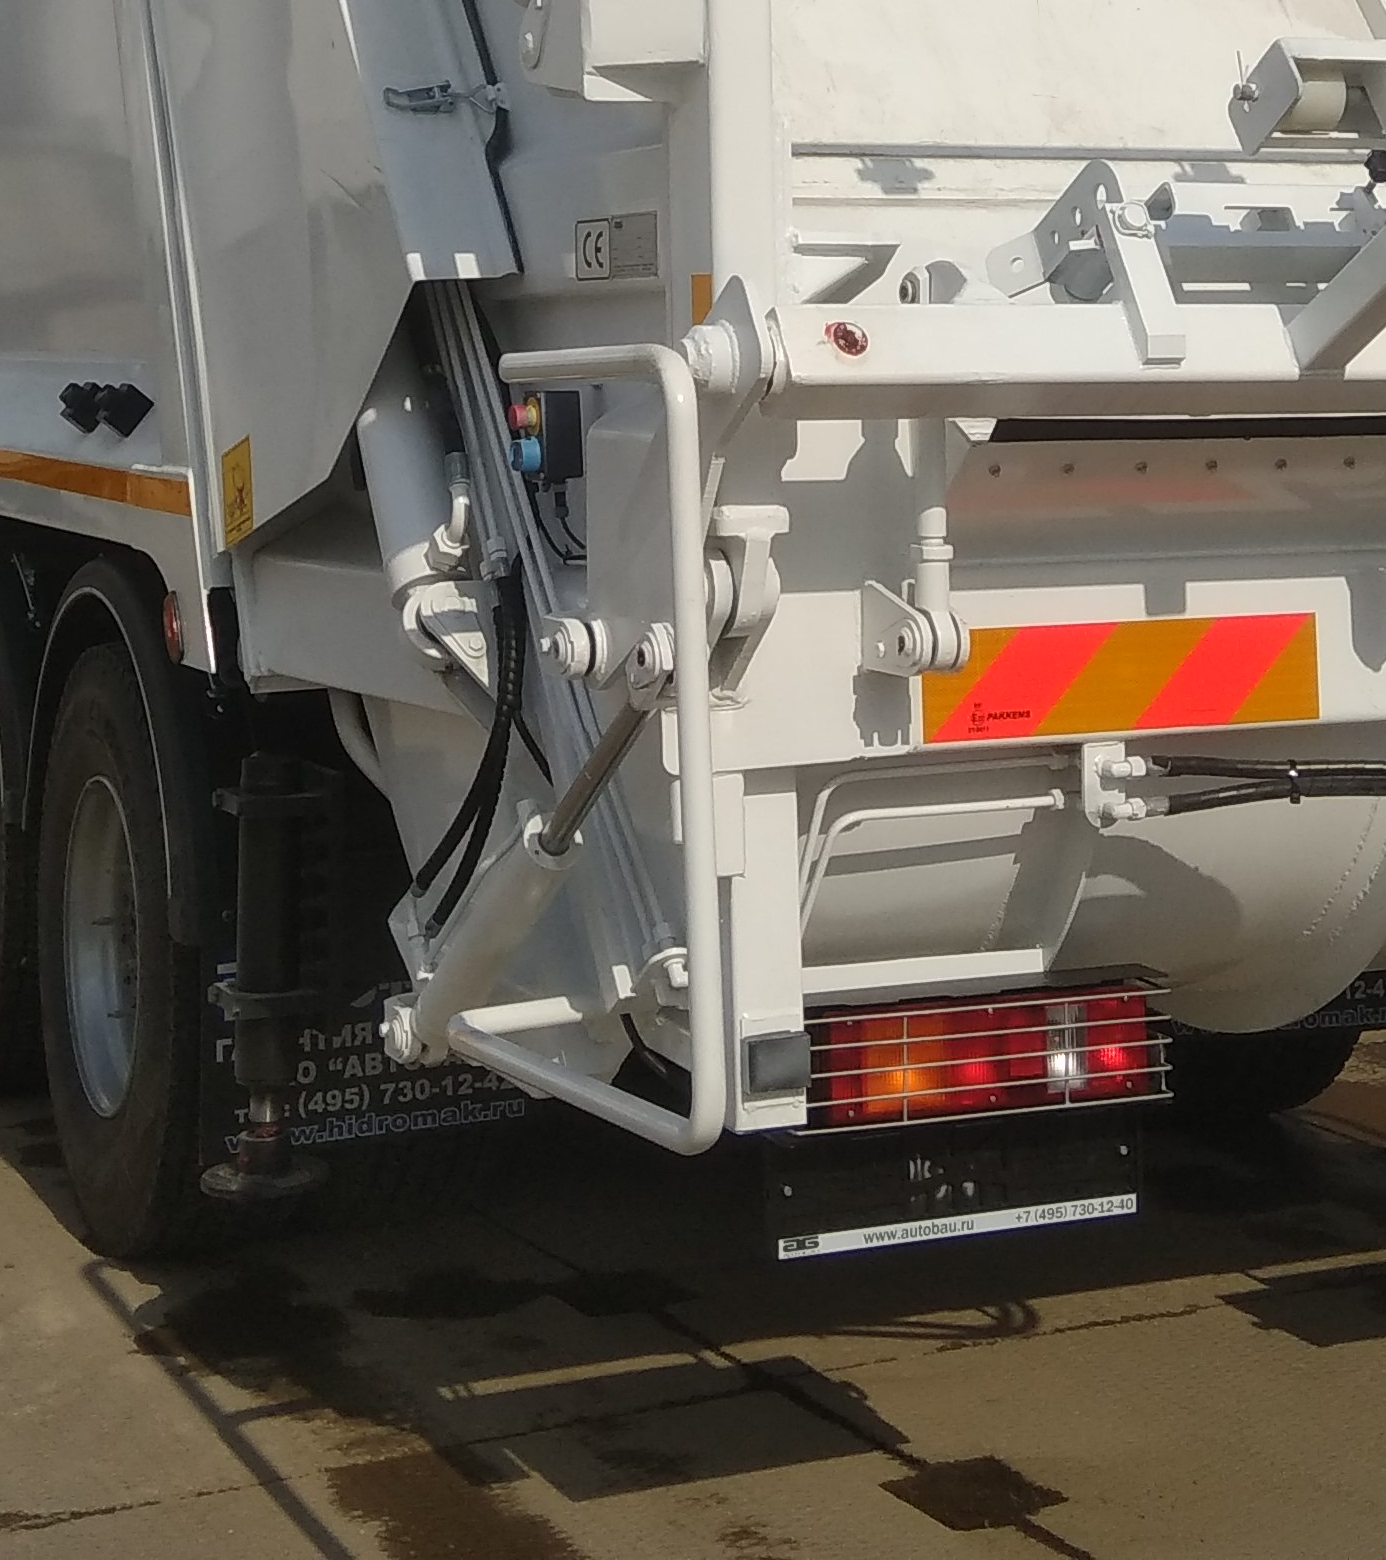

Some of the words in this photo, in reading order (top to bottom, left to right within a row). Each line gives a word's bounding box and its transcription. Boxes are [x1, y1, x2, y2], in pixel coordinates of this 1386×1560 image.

[582, 230, 604, 269] CE
[298, 1083, 370, 1119] (495)
[224, 1098, 525, 1154] w.hidromak.ru
[863, 1209, 975, 1244] www.autobau.ru
[1015, 1209, 1032, 1223] +7
[1034, 1202, 1068, 1224] (495)
[1071, 1197, 1134, 1217] 730-12-40
